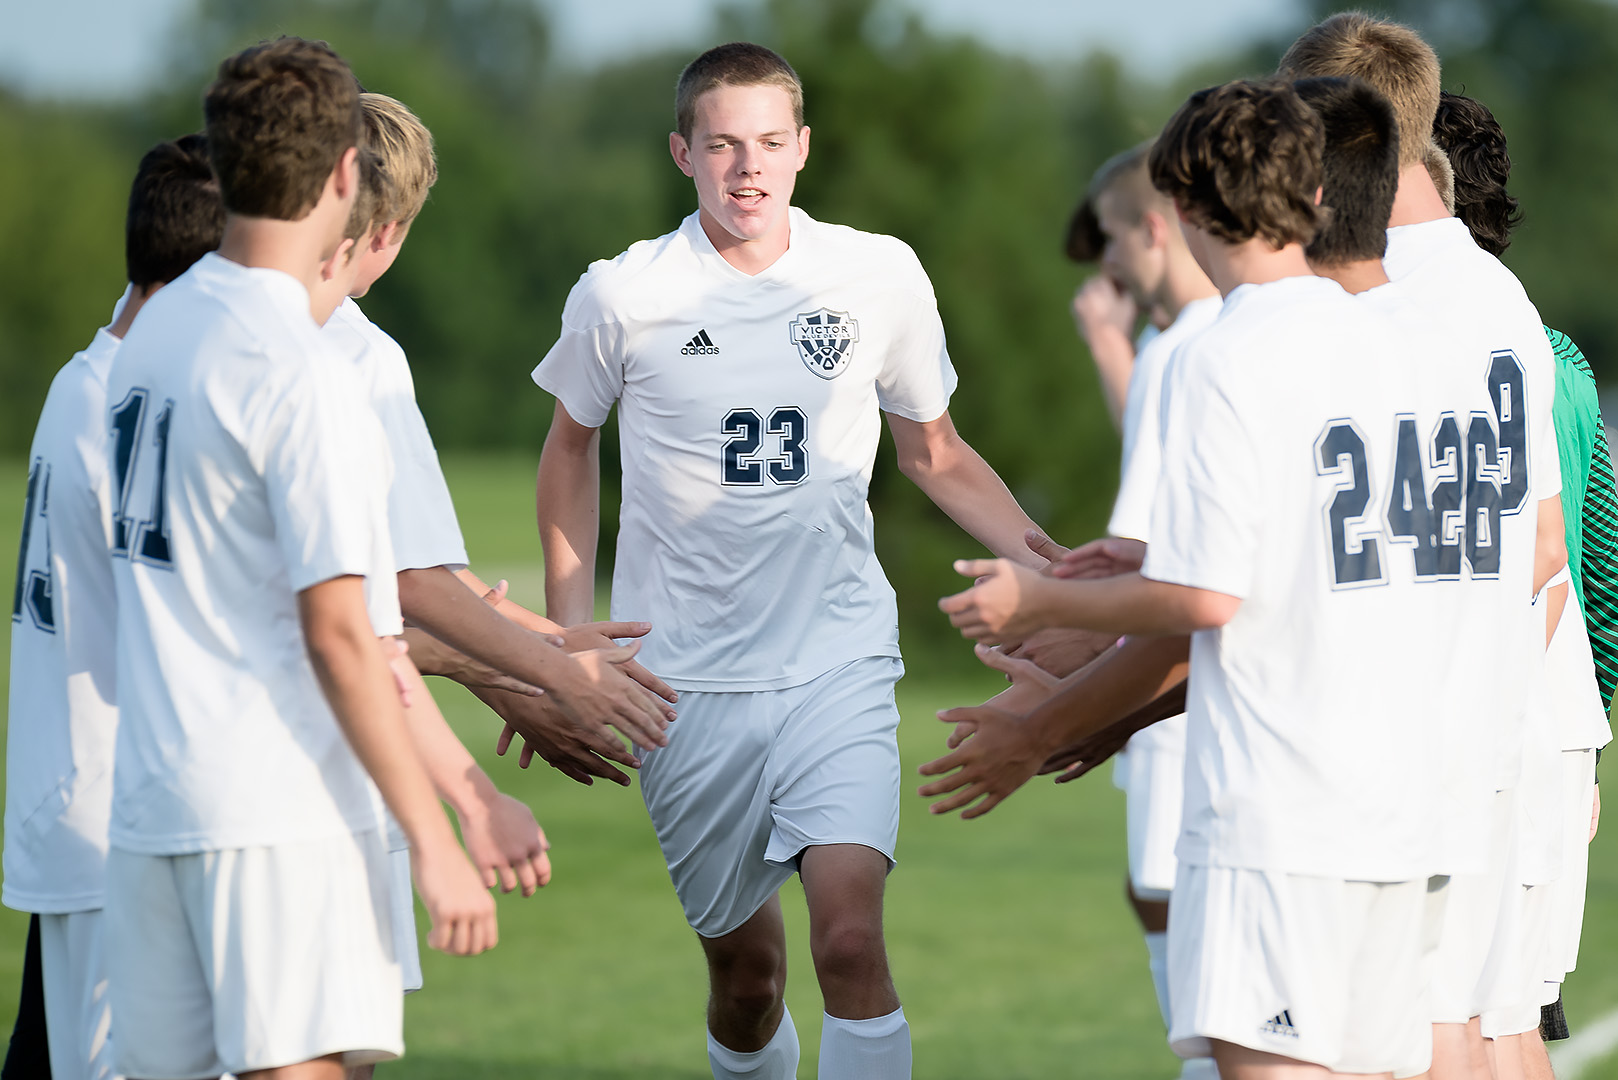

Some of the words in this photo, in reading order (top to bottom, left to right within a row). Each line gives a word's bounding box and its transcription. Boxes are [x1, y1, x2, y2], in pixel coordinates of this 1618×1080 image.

[680, 345, 720, 356] adidas
[801, 325, 848, 334] VICTOR
[721, 405, 809, 486] 23
[110, 386, 174, 572] 11
